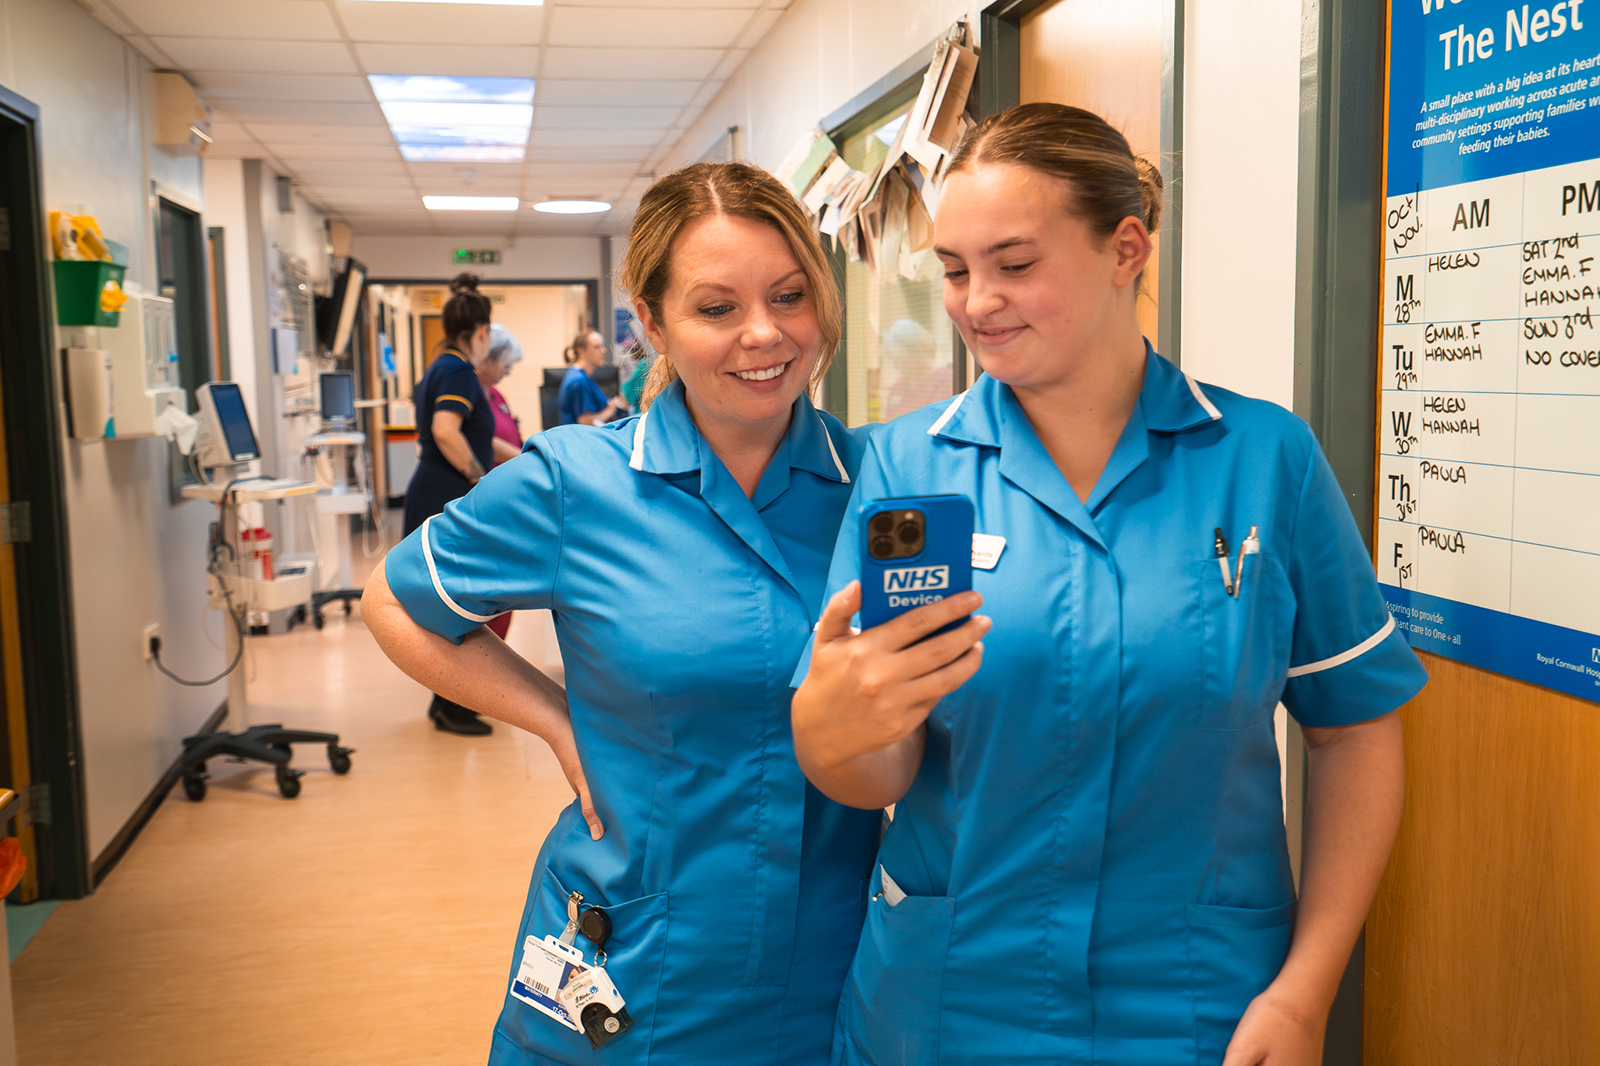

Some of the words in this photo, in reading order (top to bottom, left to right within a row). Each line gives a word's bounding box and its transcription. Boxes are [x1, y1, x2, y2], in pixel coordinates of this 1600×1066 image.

[1439, 24, 1494, 70] The
[1505, 0, 1584, 52] Nest
[1420, 101, 1427, 113] A
[1428, 94, 1450, 111] small
[1450, 91, 1473, 108] place
[1475, 82, 1495, 98] with
[1497, 83, 1503, 92] a
[1505, 76, 1520, 91] big
[1522, 71, 1543, 86] idea
[1545, 66, 1556, 79] at
[1557, 63, 1571, 76] its
[1572, 53, 1600, 72] heart
[1415, 107, 1485, 131] multi-disciplinary
[1487, 95, 1525, 113] working
[1527, 87, 1557, 103] across
[1559, 78, 1588, 95] acute
[1412, 129, 1456, 148] community
[1458, 122, 1492, 138] settings
[1493, 109, 1544, 130] supporting
[1547, 98, 1587, 117] families
[1458, 139, 1491, 155] feeding
[1494, 132, 1515, 147] their
[1517, 126, 1550, 143] babies.
[1452, 199, 1490, 231] AM
[1562, 180, 1600, 216] PM
[1428, 252, 1480, 273] HELEN
[1522, 240, 1549, 262] SAT
[1579, 257, 1594, 276] F
[1396, 274, 1413, 301] M
[1471, 322, 1481, 339] F
[1524, 317, 1558, 340] SUN
[1392, 345, 1413, 370] Tu
[1425, 344, 1482, 362] HANNAH
[1526, 350, 1552, 365] NO
[1560, 350, 1600, 368] COVE
[1424, 396, 1466, 413] HELEN
[1391, 411, 1412, 437] W
[1422, 418, 1480, 436] HANNAH
[1420, 461, 1467, 484] PAULA
[1388, 474, 1411, 502] Th
[1418, 526, 1465, 554] PAULA
[1394, 543, 1403, 568] F
[886, 567, 947, 592] NHS
[1411, 607, 1419, 618] to
[1420, 612, 1444, 625] provide
[1410, 624, 1424, 635] care
[1425, 626, 1432, 637] to
[1433, 629, 1447, 641] One
[1452, 634, 1461, 645] all
[1537, 653, 1554, 665] Royal
[1555, 658, 1585, 673] Cornwall
